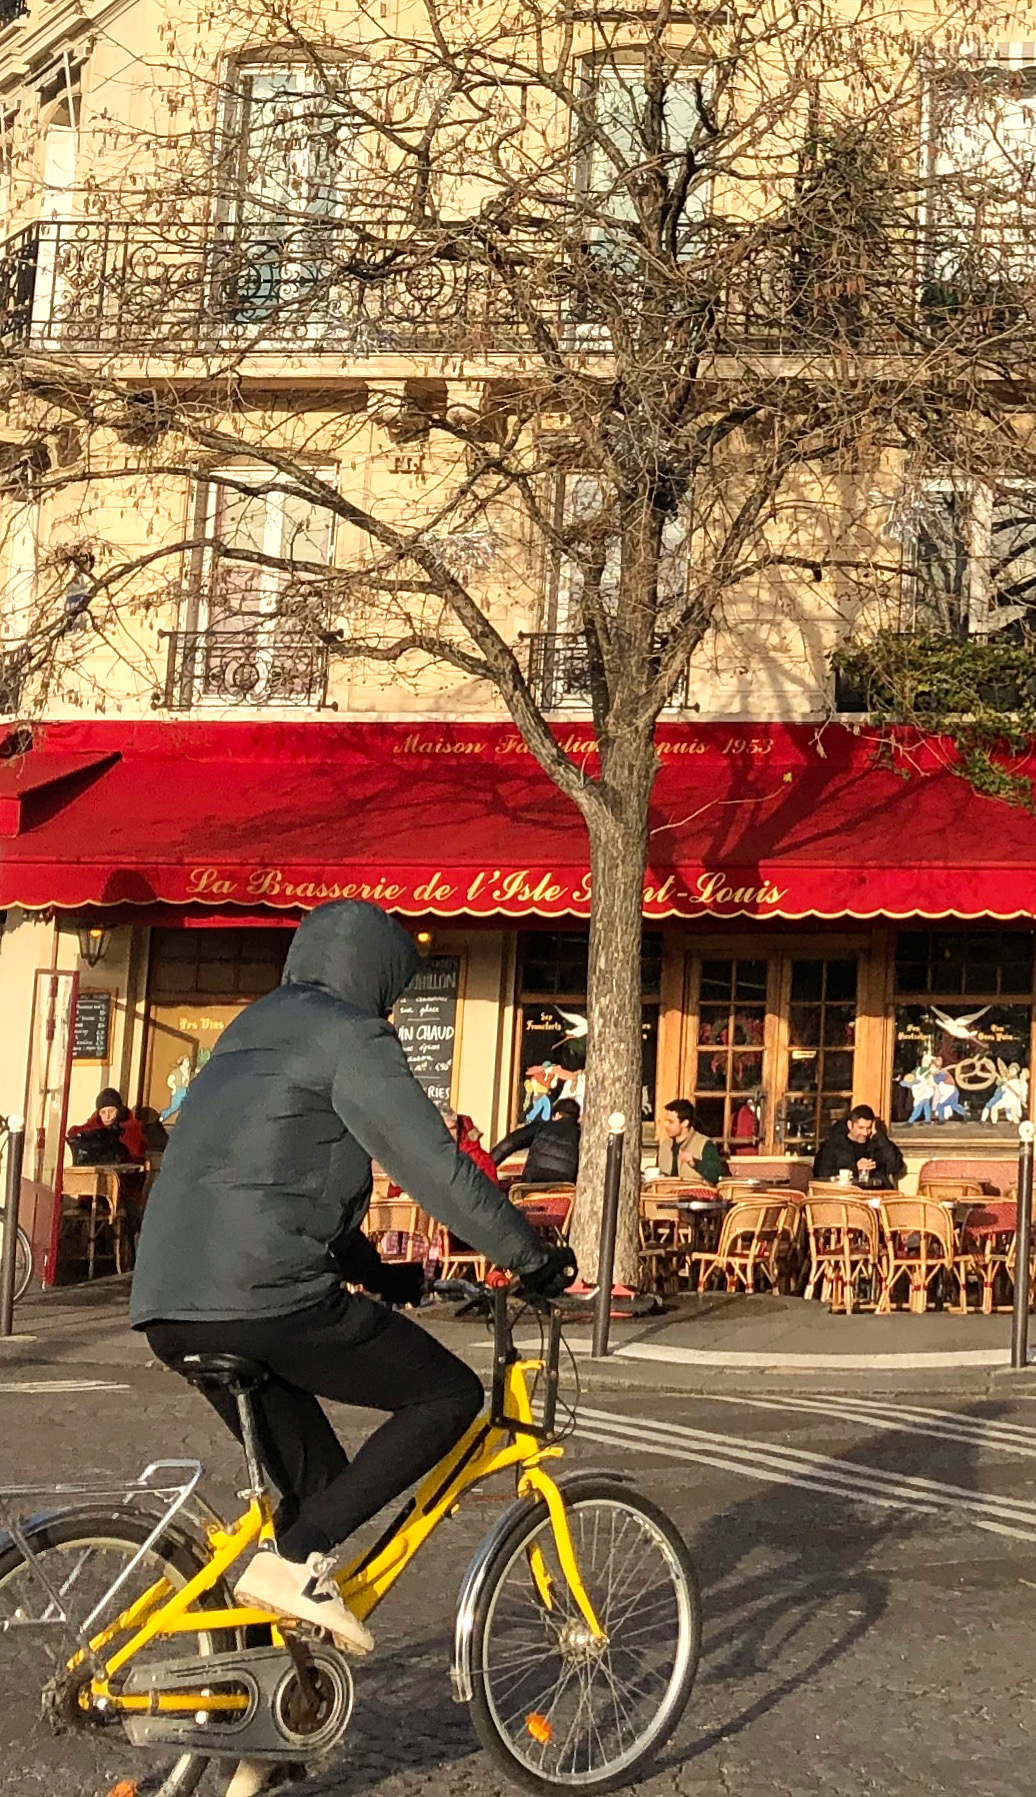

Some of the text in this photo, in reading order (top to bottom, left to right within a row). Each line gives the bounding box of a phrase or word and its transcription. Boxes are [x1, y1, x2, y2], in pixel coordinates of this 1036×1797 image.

[393, 734, 484, 754] Maison
[722, 738, 774, 755] 1953
[184, 868, 788, 904] La Brasserie de l'Isle Snt-Louis
[415, 1024, 454, 1041] CHAUD
